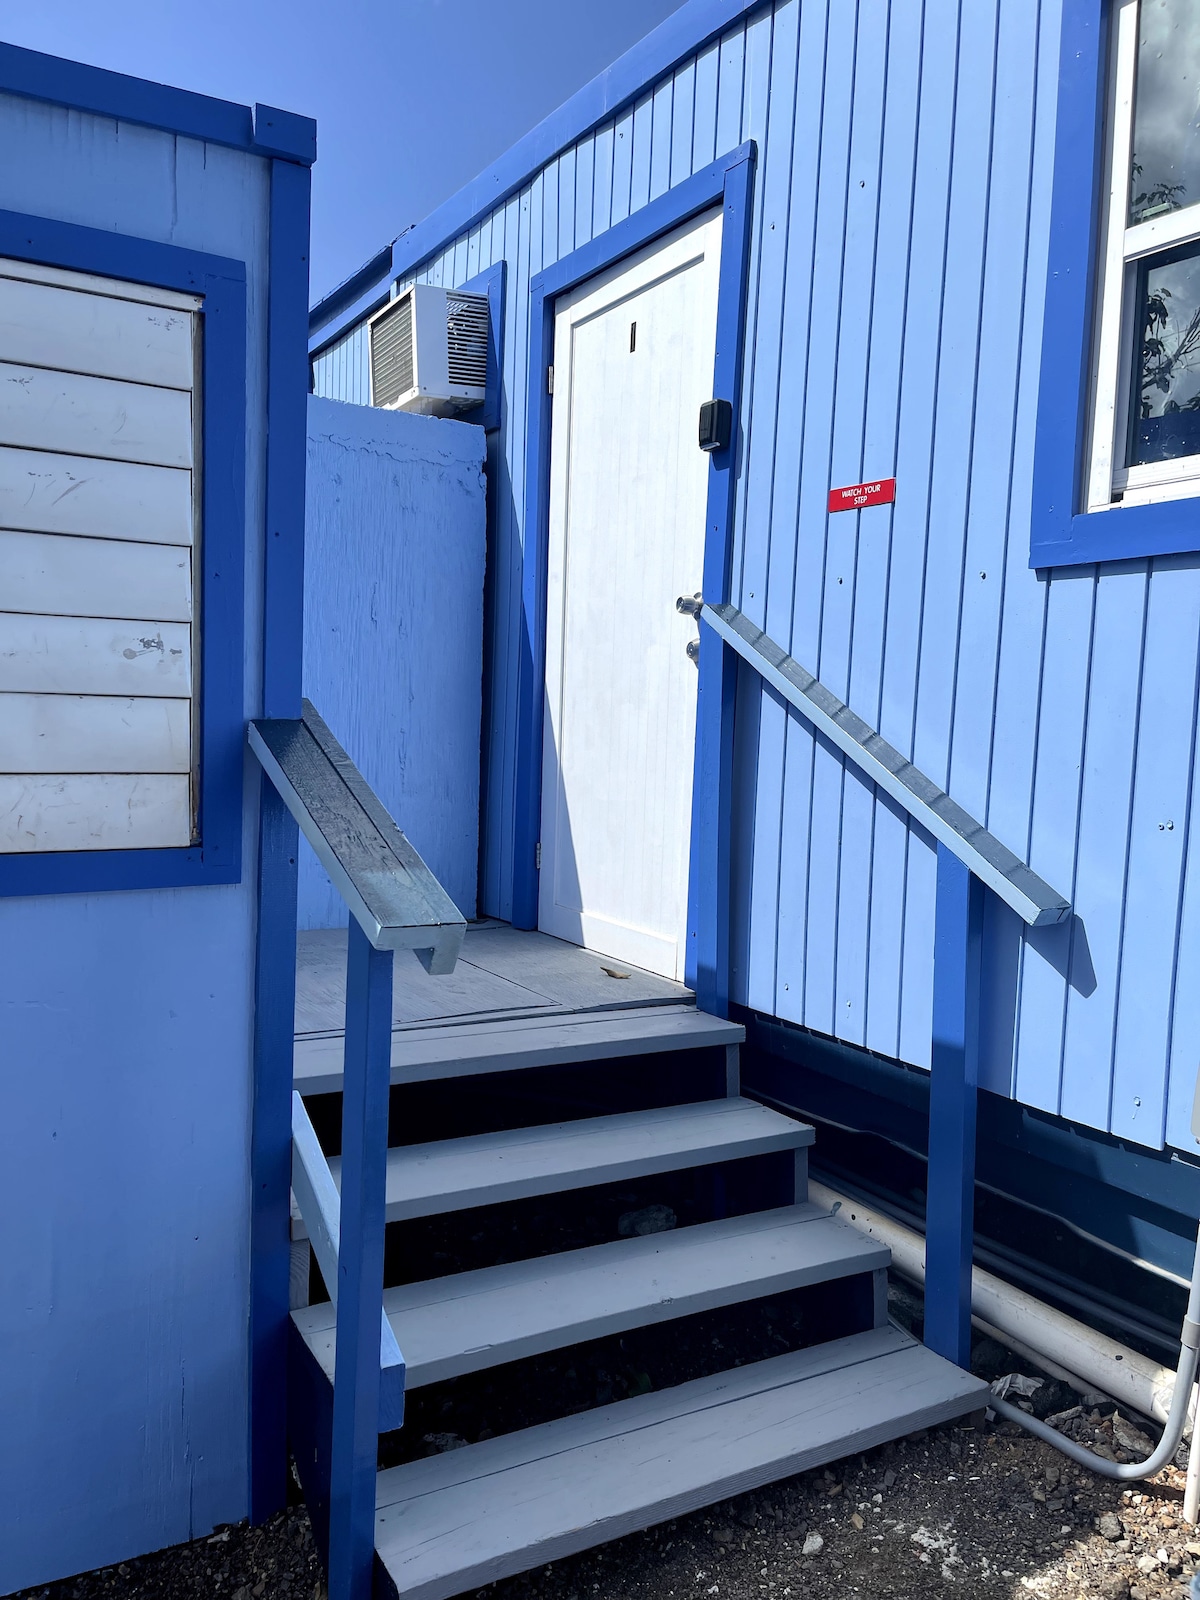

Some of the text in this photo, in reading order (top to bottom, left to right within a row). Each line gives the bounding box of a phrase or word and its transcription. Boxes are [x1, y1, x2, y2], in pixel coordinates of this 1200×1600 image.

[842, 484, 881, 498] WATCH YOUR
[854, 496, 868, 505] STEP
